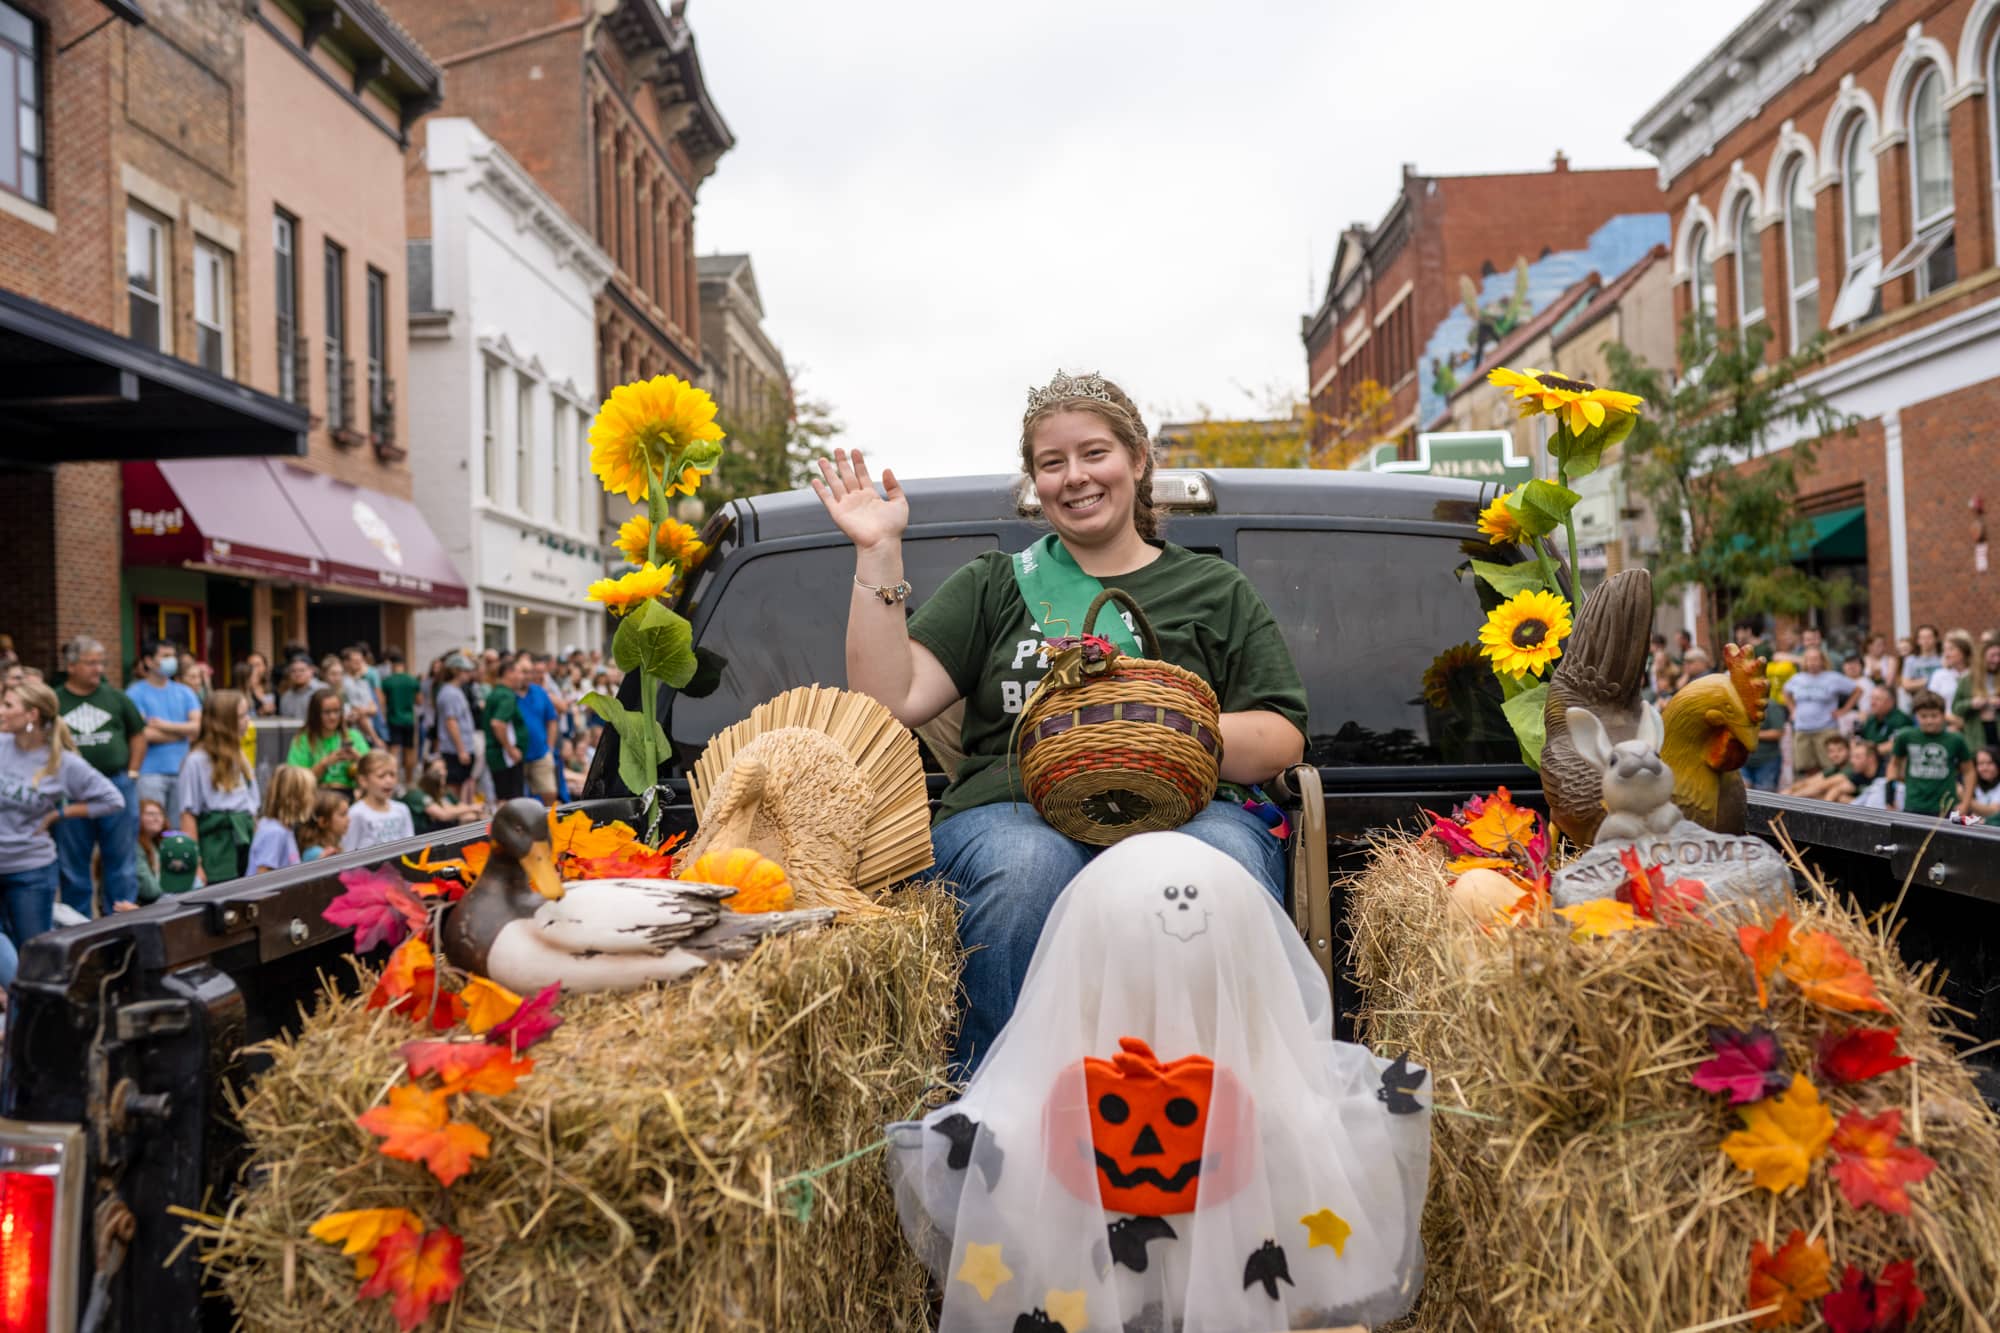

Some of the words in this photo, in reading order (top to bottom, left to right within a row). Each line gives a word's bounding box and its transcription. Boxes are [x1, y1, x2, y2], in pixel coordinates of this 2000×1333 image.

[1430, 458, 1506, 477] ATHENA
[128, 507, 184, 536] Bagel
[1564, 839, 1763, 883] WECOME
